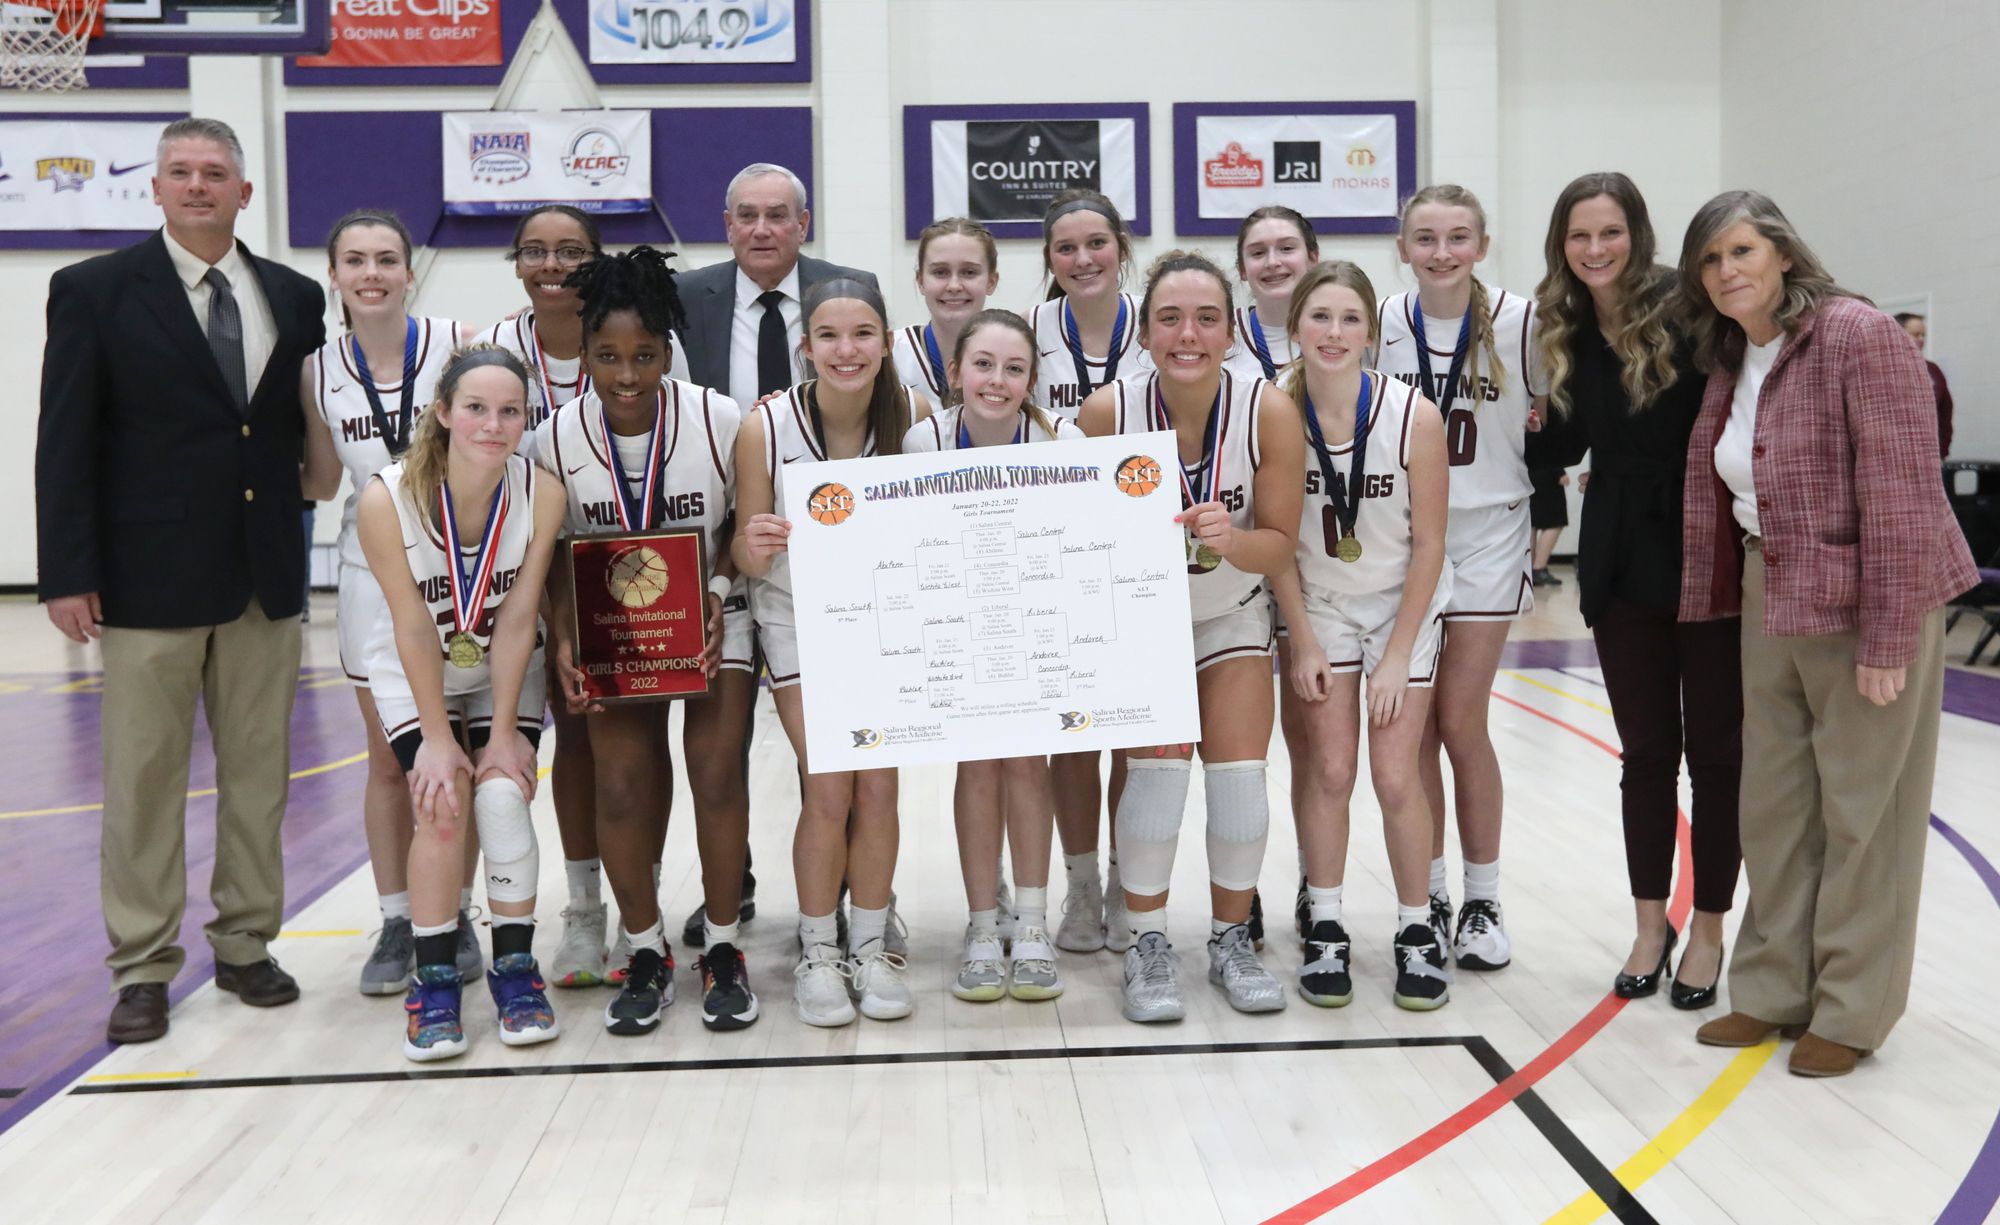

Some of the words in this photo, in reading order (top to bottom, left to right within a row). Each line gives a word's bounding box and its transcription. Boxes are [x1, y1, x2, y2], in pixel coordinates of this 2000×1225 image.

[331, 0, 402, 16] reat
[343, 28, 399, 40] GONNA
[405, 28, 424, 39] BE
[430, 28, 477, 39] GREAT
[633, 7, 750, 50] 104.9
[472, 134, 527, 154] NAIA
[573, 156, 619, 170] KCAC
[1278, 162, 1317, 180] JRI
[107, 189, 148, 199] TEA
[864, 480, 913, 502] SALINA
[914, 465, 1008, 498] INVITATIONAL
[1007, 465, 1101, 489] TOURNAMENT
[952, 502, 979, 512] January
[1003, 498, 1019, 507] 2022
[963, 510, 978, 518] Girls
[979, 508, 1015, 517] Tournament
[1040, 526, 1066, 536] Central
[920, 537, 949, 547] Abilene
[1063, 545, 1085, 553] Salina
[1089, 540, 1116, 551] Central
[876, 560, 903, 570] Abilene
[1021, 572, 1056, 581] Concordia
[1113, 575, 1138, 584] Salina
[1140, 569, 1169, 581] Central
[824, 604, 847, 614] Salina
[850, 602, 872, 614] South
[593, 613, 627, 625] Salina
[629, 608, 686, 623] Invitational
[923, 617, 943, 626] Salina
[946, 615, 965, 624] South
[609, 627, 674, 640] Tournament
[880, 647, 900, 656] Salina
[903, 646, 922, 655] South
[587, 663, 623, 676] GIRLS
[626, 657, 700, 673] CHAMPIONS
[631, 677, 659, 689] 2022
[1117, 705, 1151, 713] Regional
[1093, 716, 1116, 724] Sports
[1118, 713, 1152, 721] Medicine
[908, 722, 941, 731] Regional
[884, 733, 907, 741] Sports
